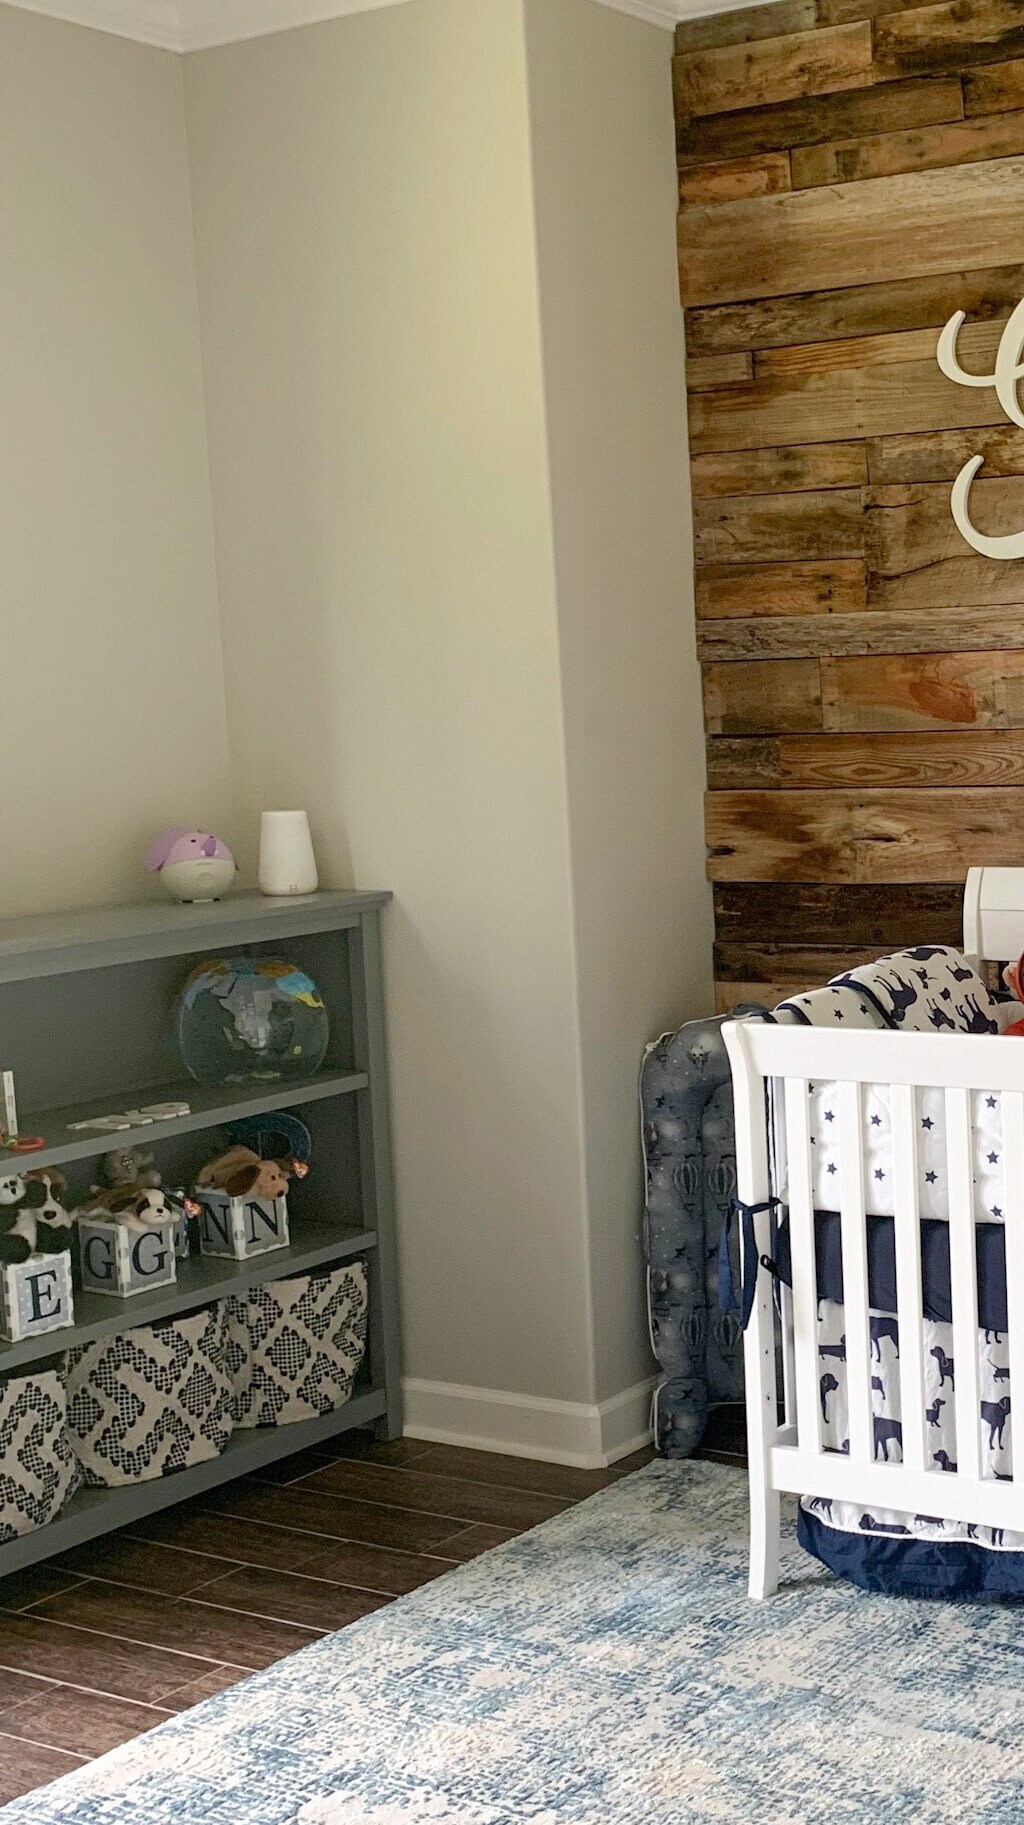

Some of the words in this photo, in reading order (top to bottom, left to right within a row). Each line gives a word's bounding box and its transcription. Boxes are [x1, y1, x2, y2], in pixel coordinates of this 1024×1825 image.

[202, 1202, 230, 1245] N
[245, 1200, 279, 1243] N
[84, 1236, 115, 1279] G
[132, 1230, 168, 1275] G
[25, 1269, 61, 1323] E
